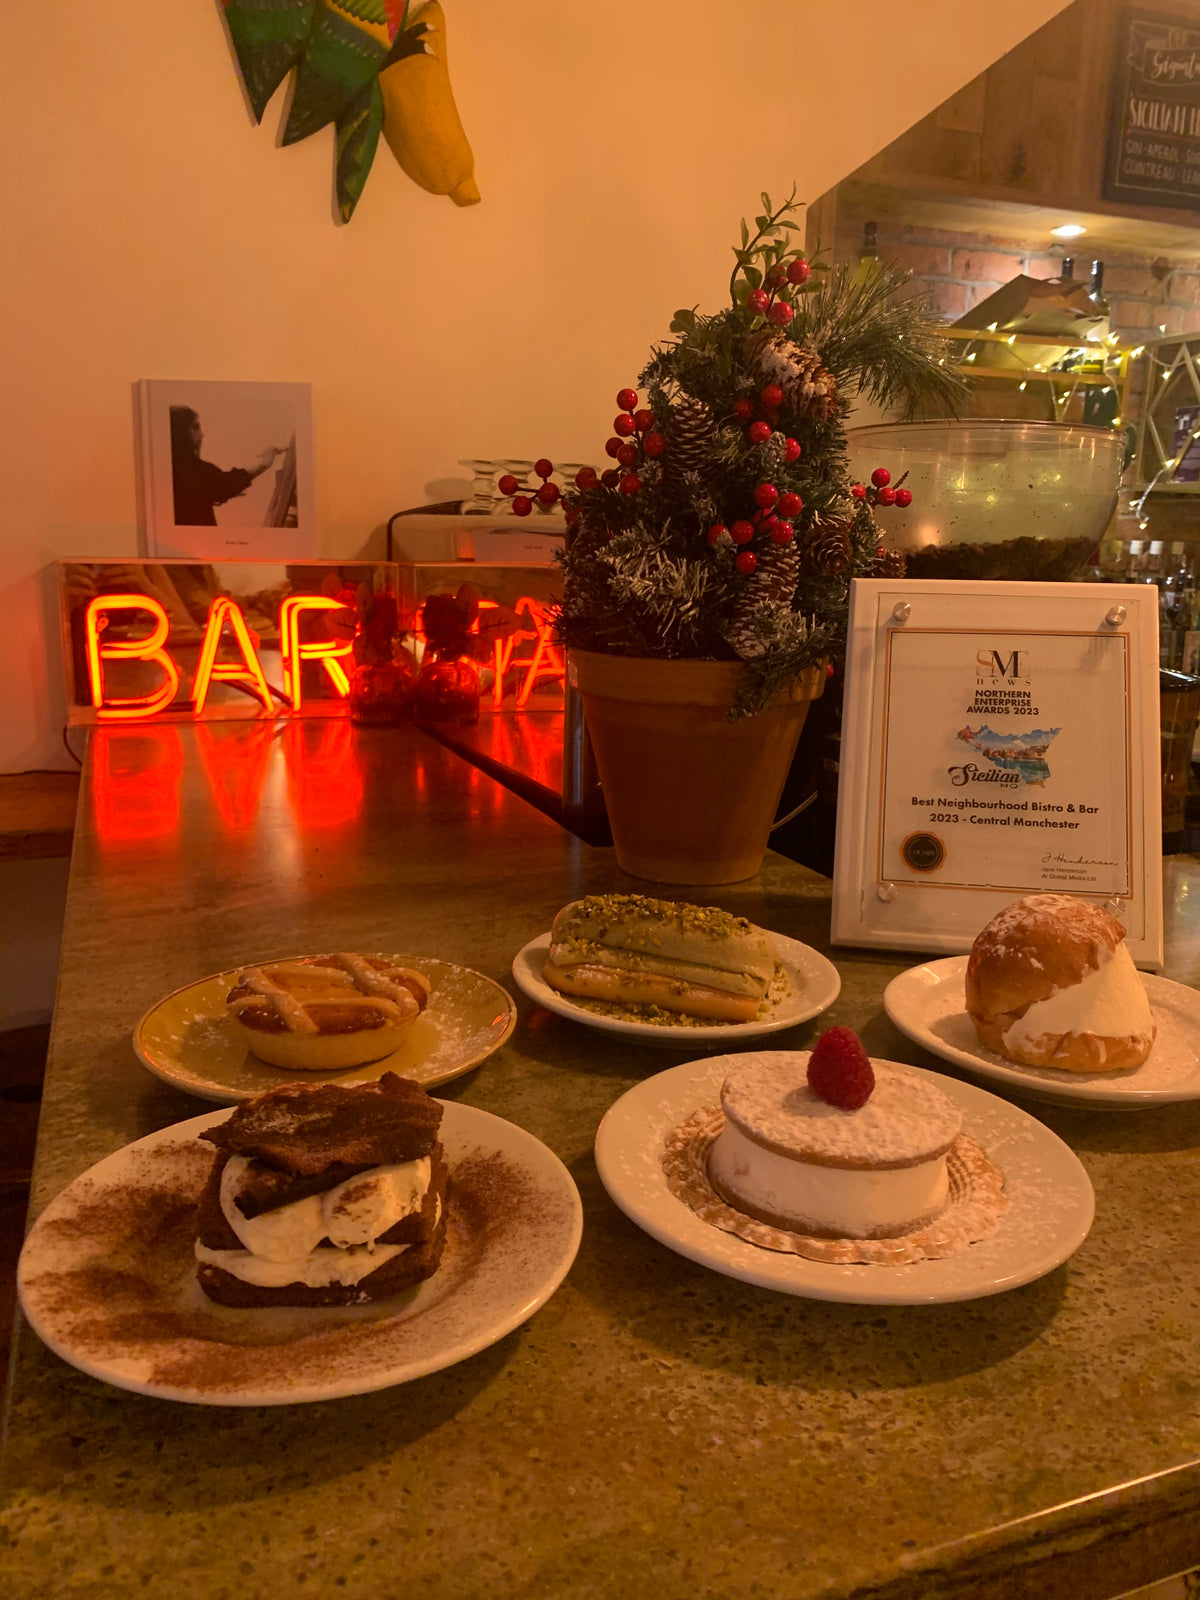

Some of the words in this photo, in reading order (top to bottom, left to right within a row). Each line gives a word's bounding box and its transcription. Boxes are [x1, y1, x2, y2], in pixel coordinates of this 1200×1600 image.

[85, 594, 354, 718] BAR
[975, 689, 1031, 698] NORTHERN
[974, 698, 1031, 706] ENTERPRISE
[966, 706, 1010, 714] AWARDS
[1013, 707, 1039, 715] 2023
[948, 763, 1020, 787] Sicilian
[911, 797, 935, 806] Best
[937, 798, 1028, 811] Neighbourhood
[1031, 802, 1063, 812] Bistro
[1066, 804, 1075, 813] &
[1079, 804, 1099, 814] Bar
[929, 813, 959, 823] 2023
[969, 815, 1010, 825] Central
[1013, 817, 1080, 829] Manchester
